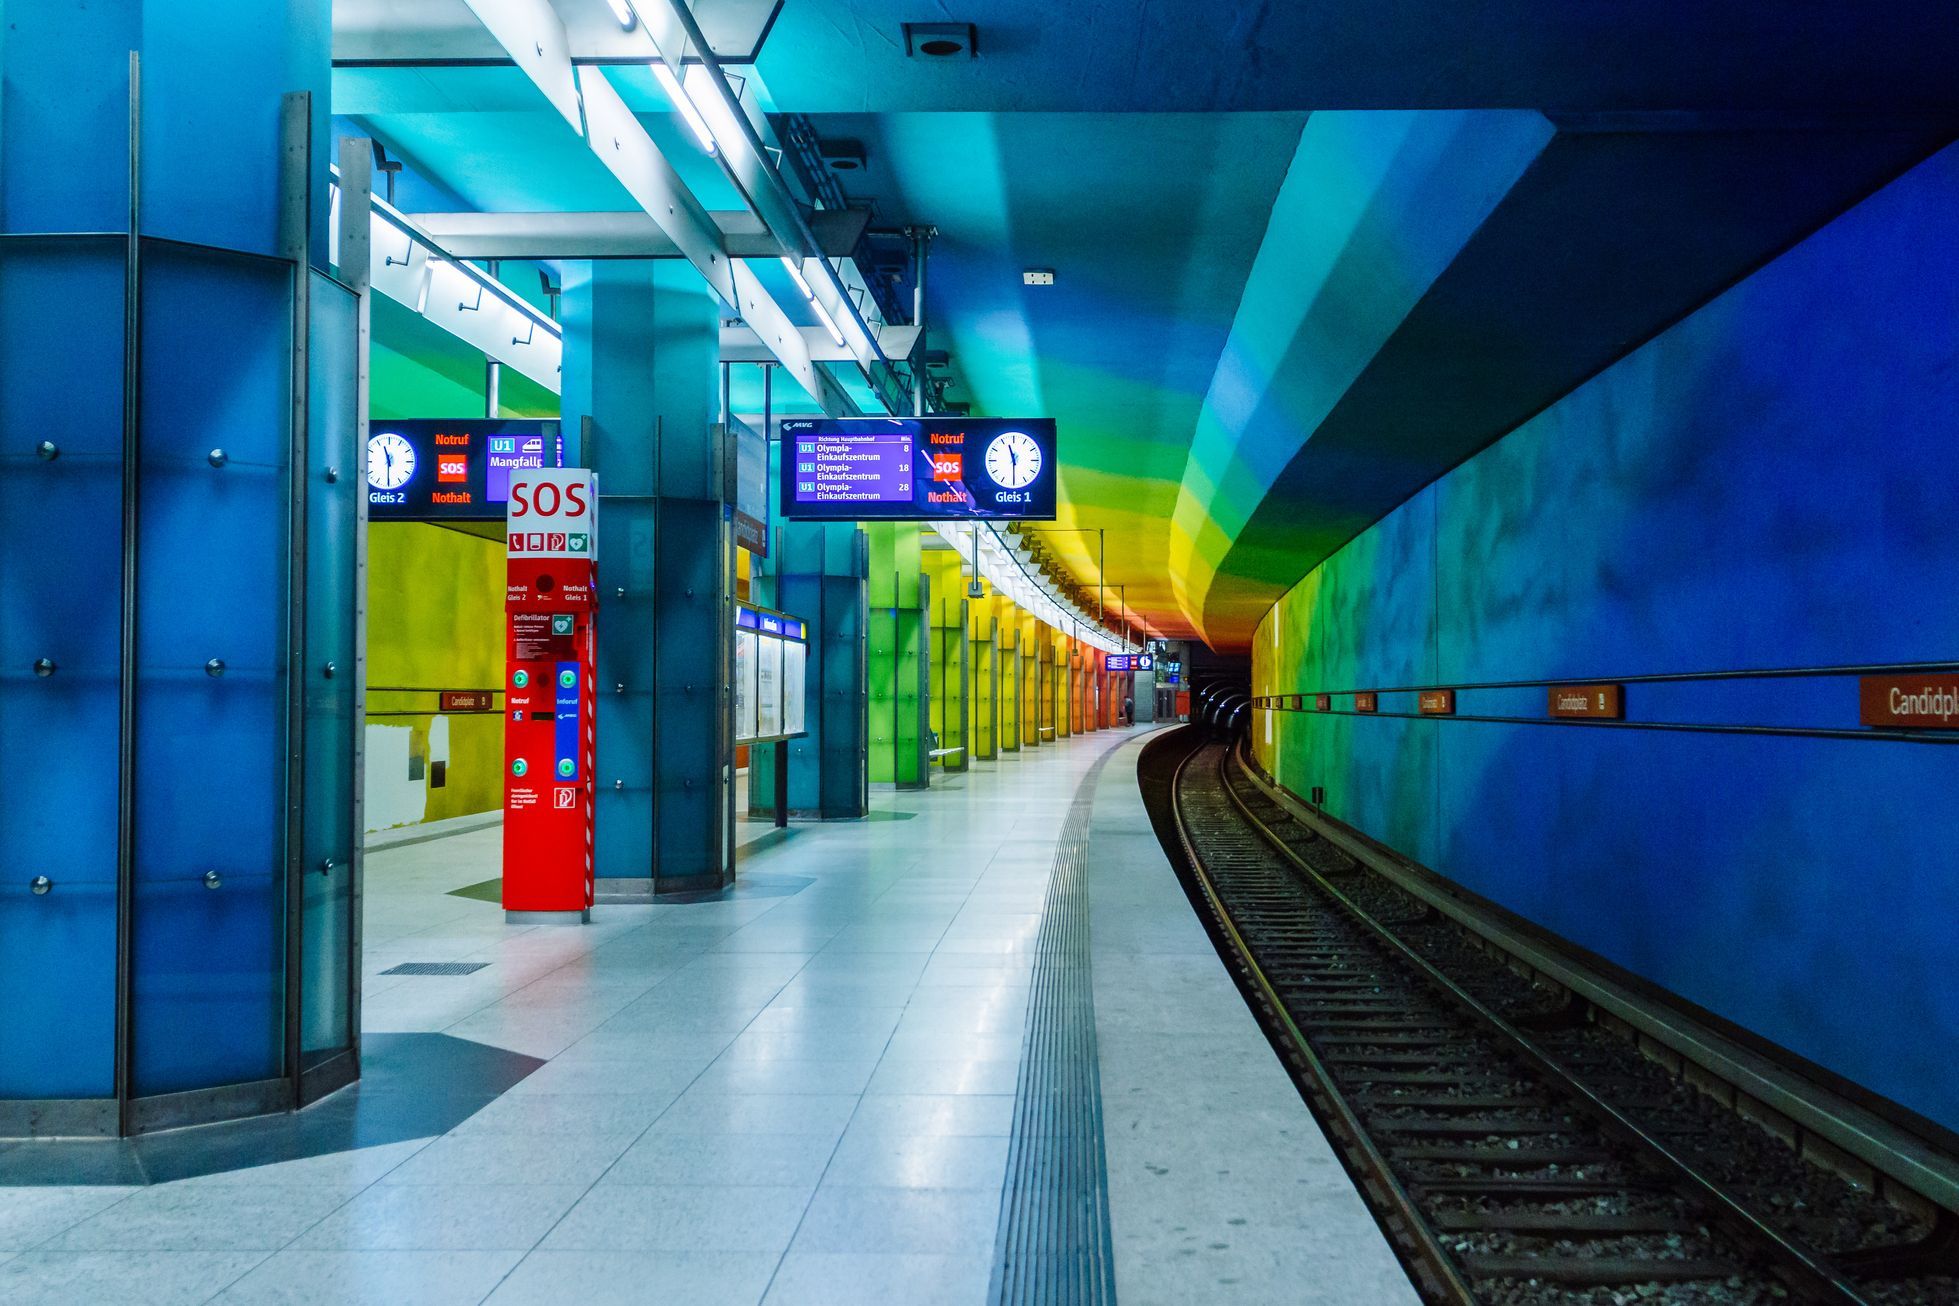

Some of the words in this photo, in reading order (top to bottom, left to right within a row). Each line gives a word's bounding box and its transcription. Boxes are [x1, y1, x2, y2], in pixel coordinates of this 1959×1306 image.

[435, 433, 470, 445] Notruf
[930, 433, 965, 444] Notruf
[494, 440, 511, 451] U1
[801, 444, 814, 452] U1
[817, 444, 853, 454] Olympia-
[903, 444, 910, 453] 8
[817, 453, 881, 461] Einkaufszentrum
[440, 463, 465, 475] SOS
[801, 464, 814, 472] U1
[817, 463, 853, 473] Olympia-
[898, 464, 910, 473] 18
[935, 461, 960, 474] SOS
[817, 473, 881, 481] Einkaufszentrum
[801, 483, 814, 491] U1
[817, 482, 853, 493] Olympia-
[898, 483, 910, 492] 28
[369, 492, 395, 503] Gleis
[396, 492, 405, 503] 2
[432, 492, 471, 503] Nothalt
[511, 481, 586, 518] SOS
[817, 492, 881, 500] Einkaufszentrum
[928, 492, 968, 503] Nothalt
[995, 491, 1022, 503] Gleis
[1023, 491, 1032, 503] 1
[1889, 686, 1959, 722] Candidpl
